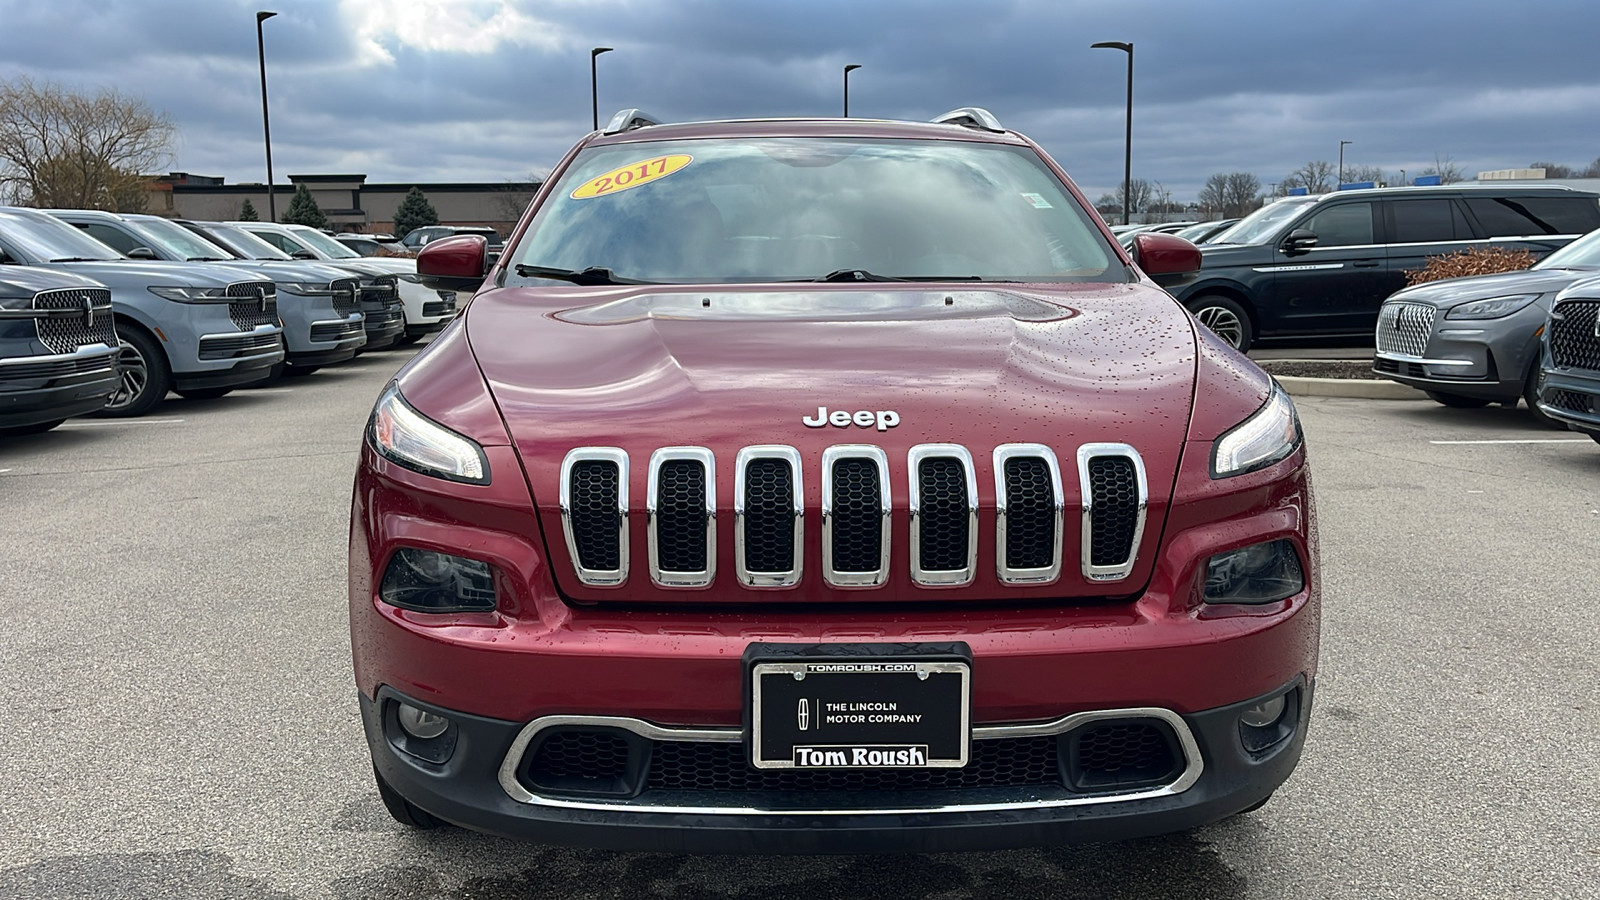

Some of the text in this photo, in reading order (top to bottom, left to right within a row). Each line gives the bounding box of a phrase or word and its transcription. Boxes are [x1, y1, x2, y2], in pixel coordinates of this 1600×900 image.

[594, 158, 667, 194] 2017
[802, 406, 900, 431] Jeep
[826, 703, 897, 711] THE LINCOLN
[826, 715, 922, 723] MOTOR COMPANY
[796, 747, 925, 766] Tom Roush
